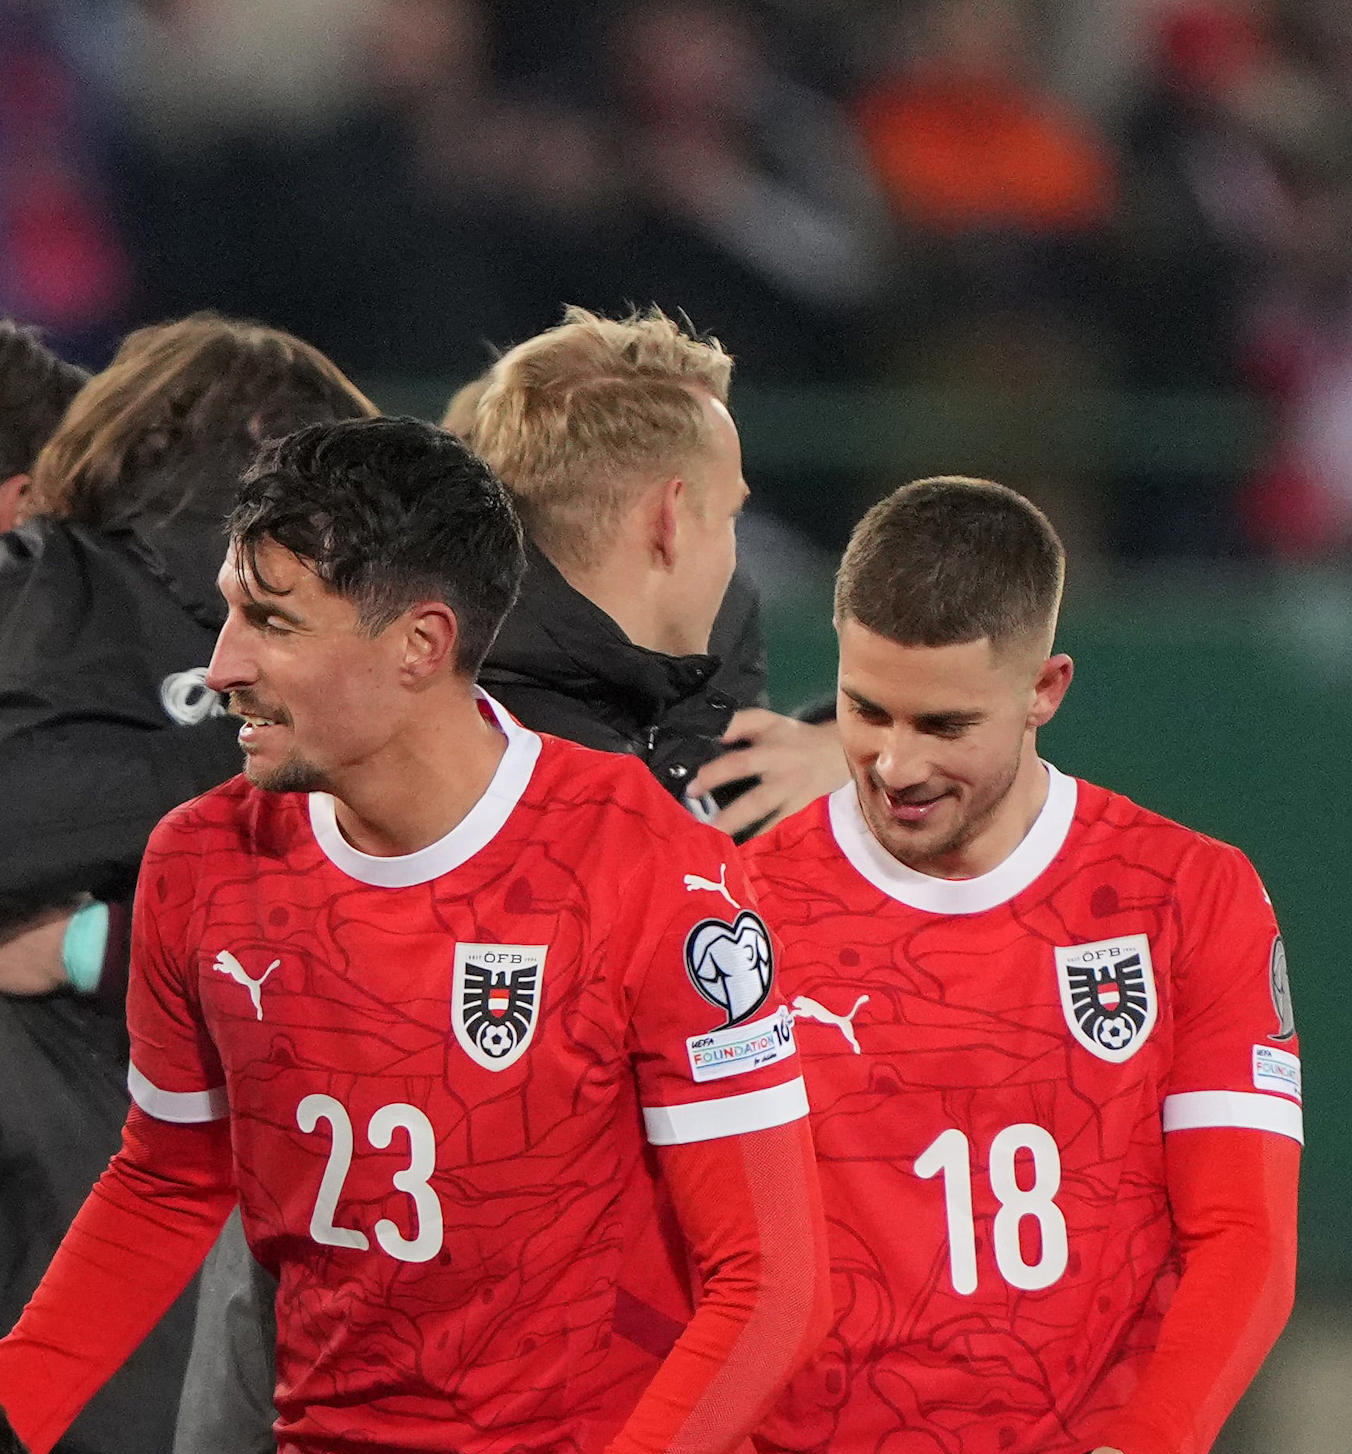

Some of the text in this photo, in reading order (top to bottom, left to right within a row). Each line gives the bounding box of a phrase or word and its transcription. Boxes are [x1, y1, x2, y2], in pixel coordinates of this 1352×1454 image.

[694, 1037, 775, 1066] FOUNDATION
[296, 1094, 444, 1264] 23
[913, 1123, 1069, 1296] 18
